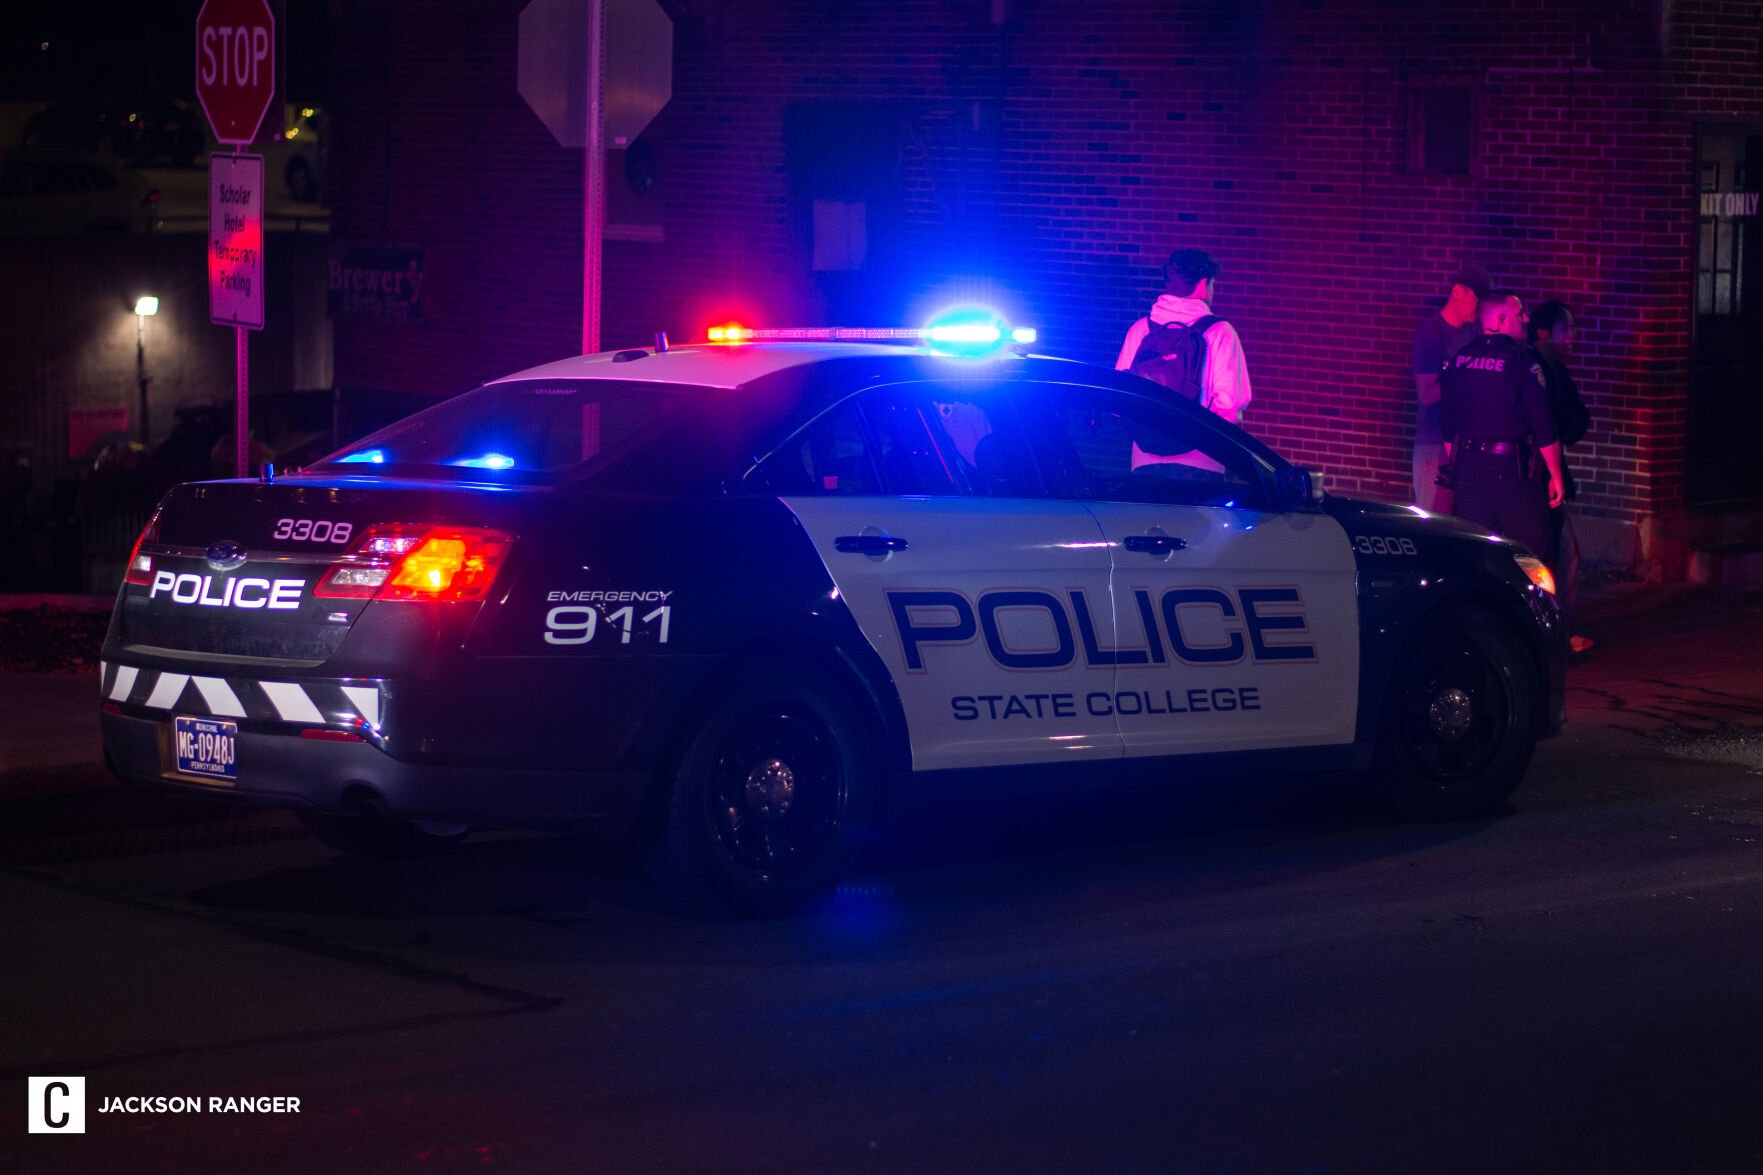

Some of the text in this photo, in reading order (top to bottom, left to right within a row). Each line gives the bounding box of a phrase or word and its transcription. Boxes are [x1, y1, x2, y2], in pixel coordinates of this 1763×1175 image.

[202, 25, 269, 87] STOP
[219, 183, 252, 205] Scholar
[1700, 192, 1760, 217] XIT ONLY
[223, 213, 246, 233] Hotel
[214, 240, 257, 269] Temporary
[219, 270, 252, 297] Parking
[327, 258, 424, 305] Brewery
[273, 517, 353, 545] 3308
[1354, 535, 1418, 556] 3308
[150, 569, 306, 610] POLICE
[546, 590, 675, 602] EMERGENCY
[543, 605, 672, 645] 911
[884, 585, 1319, 676] POLICE
[951, 687, 1262, 721] STATE COLLEGE
[178, 730, 235, 766] MG-0948J
